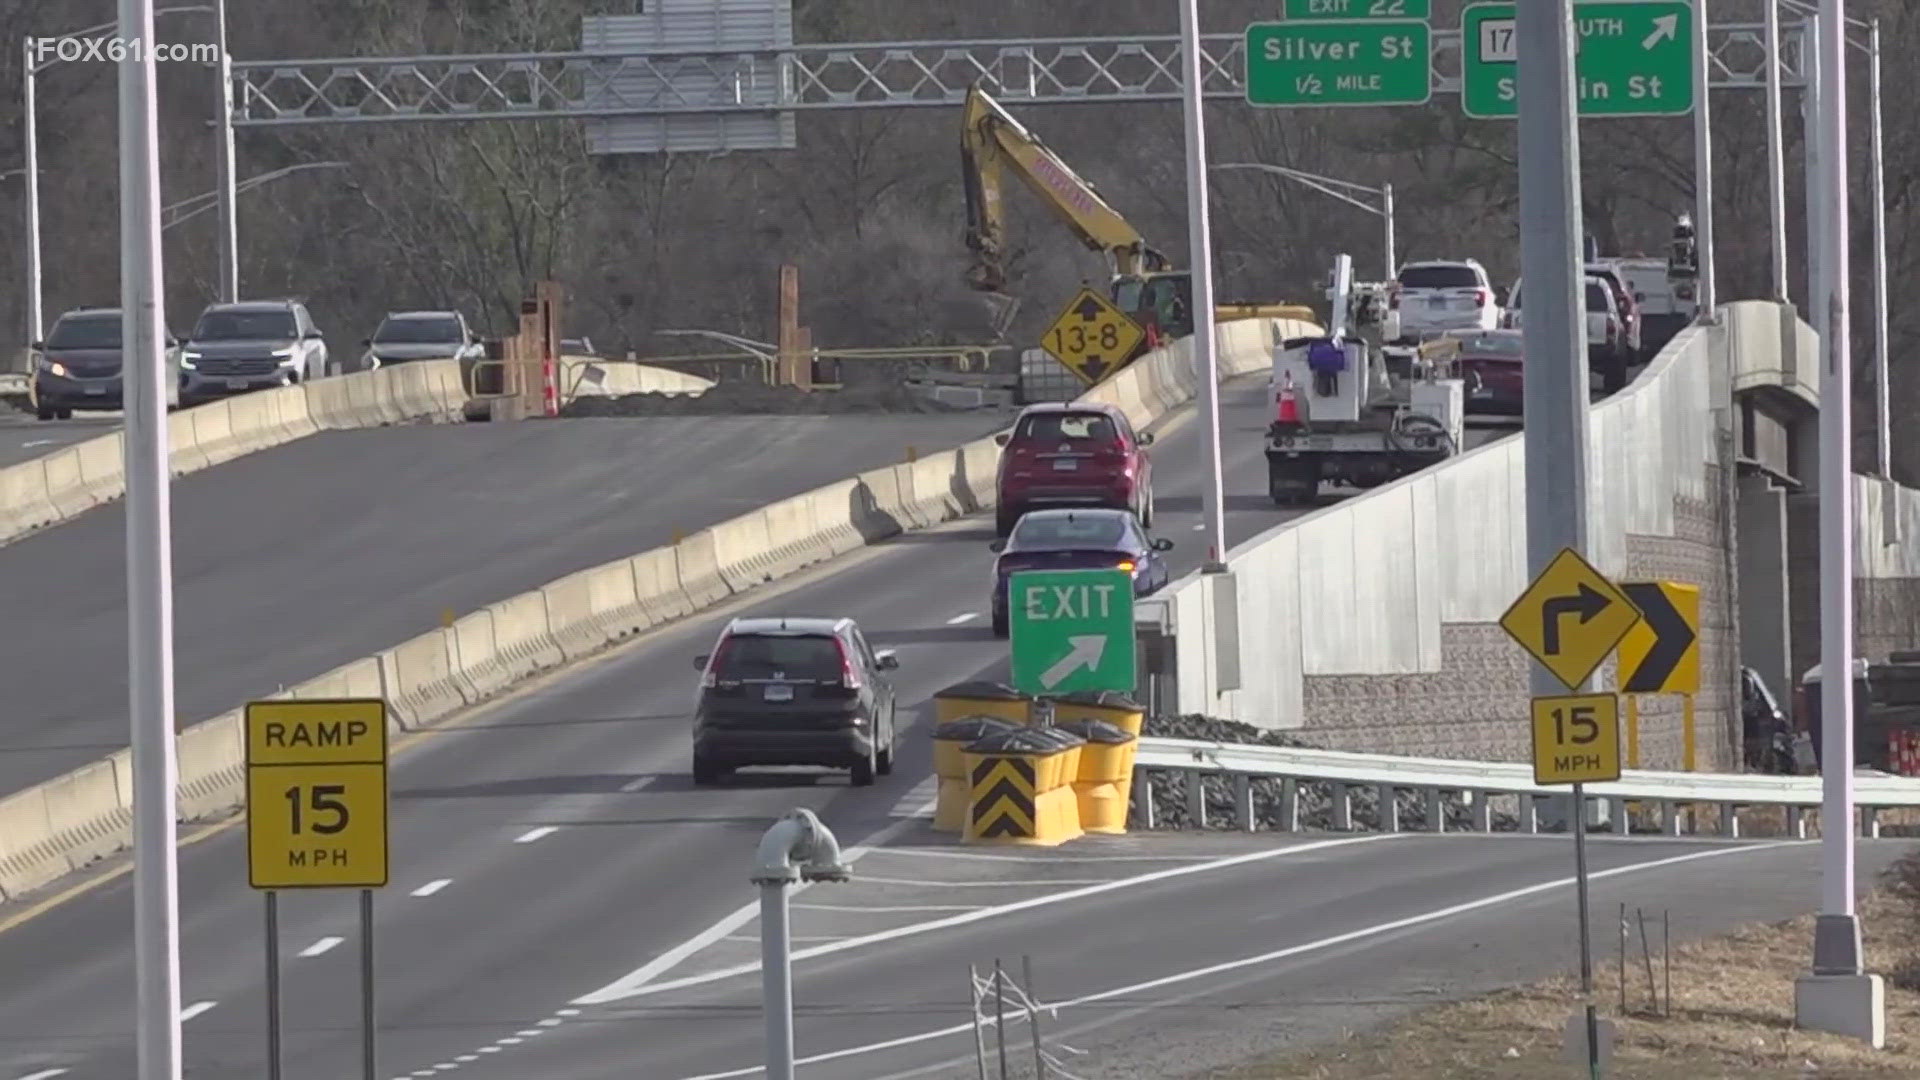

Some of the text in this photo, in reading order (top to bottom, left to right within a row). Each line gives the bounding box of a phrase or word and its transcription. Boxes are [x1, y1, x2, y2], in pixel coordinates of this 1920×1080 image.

[1308, 0, 1406, 15] EXIT 22
[1577, 18, 1624, 37] UTH
[1263, 35, 1414, 61] Silver St
[1490, 29, 1513, 53] 17
[1295, 73, 1382, 95] 1/2 MILE
[1578, 76, 1609, 99] in
[1627, 75, 1663, 99] St
[1025, 584, 1115, 621] EXIT
[265, 720, 369, 748] RAMP
[1550, 706, 1600, 746] 15
[1553, 754, 1601, 772] MPH
[284, 784, 350, 836] 15
[288, 848, 349, 868] MPH
